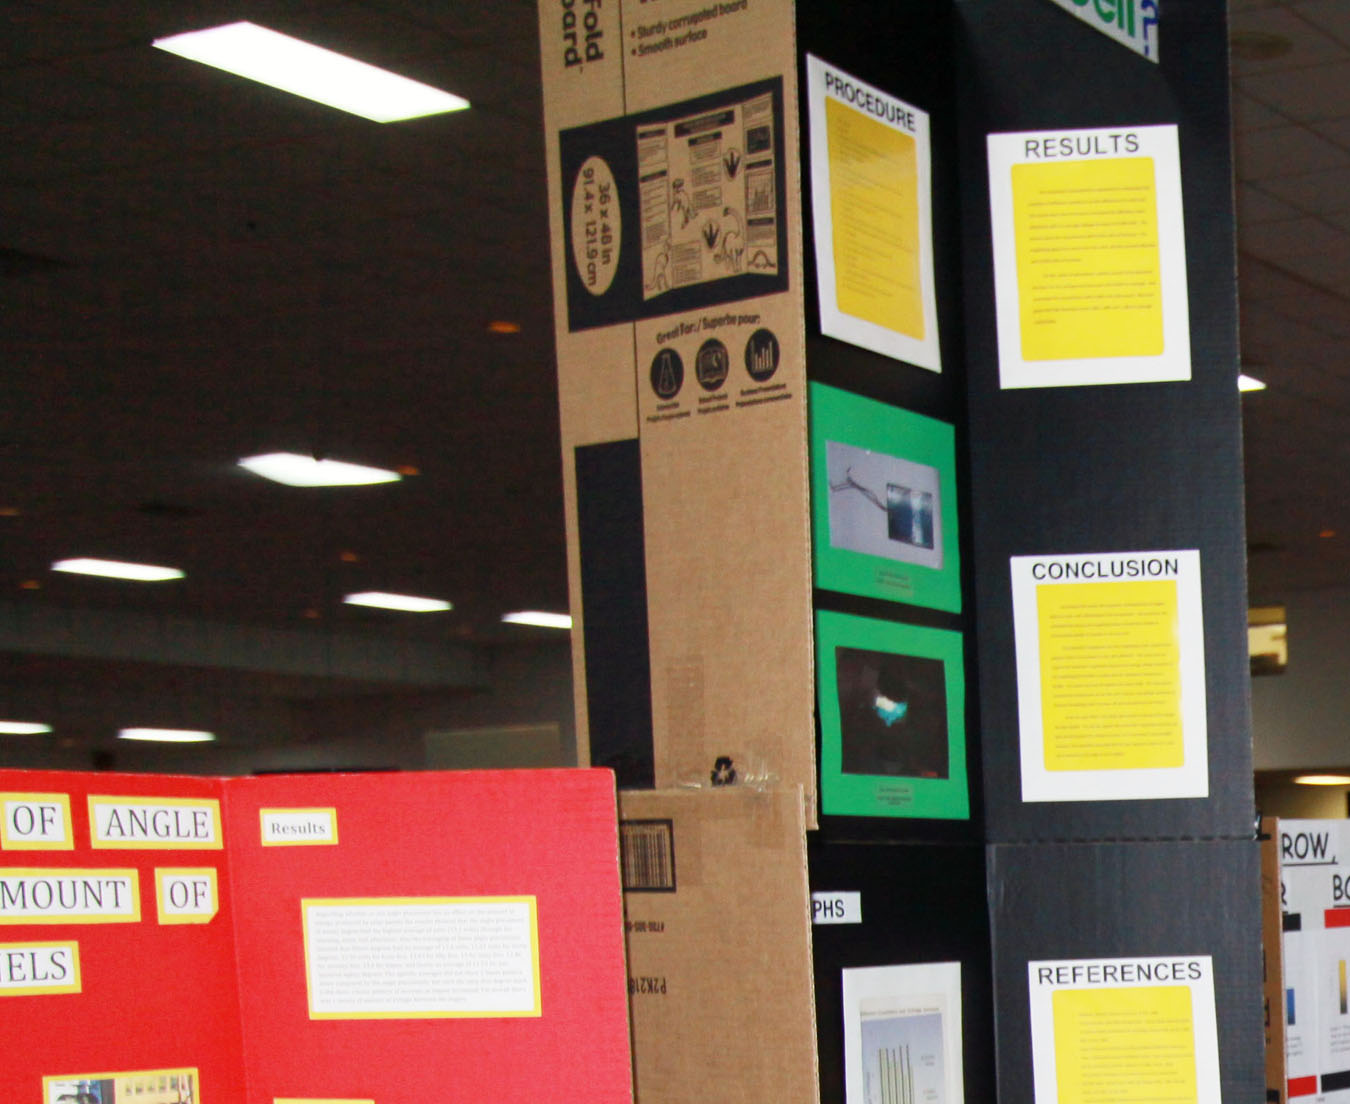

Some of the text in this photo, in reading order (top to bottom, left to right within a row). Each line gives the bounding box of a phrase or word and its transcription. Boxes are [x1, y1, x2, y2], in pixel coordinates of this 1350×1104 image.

[825, 71, 916, 133] PROCEDURE
[1025, 133, 1140, 158] RESULTS
[1032, 558, 1178, 580] CONCLUSION
[13, 805, 210, 839] OF ANGLE
[271, 821, 326, 836] Results
[169, 880, 208, 909] OF
[0, 950, 68, 982] ELS
[1038, 961, 1203, 985] REFERENCES
